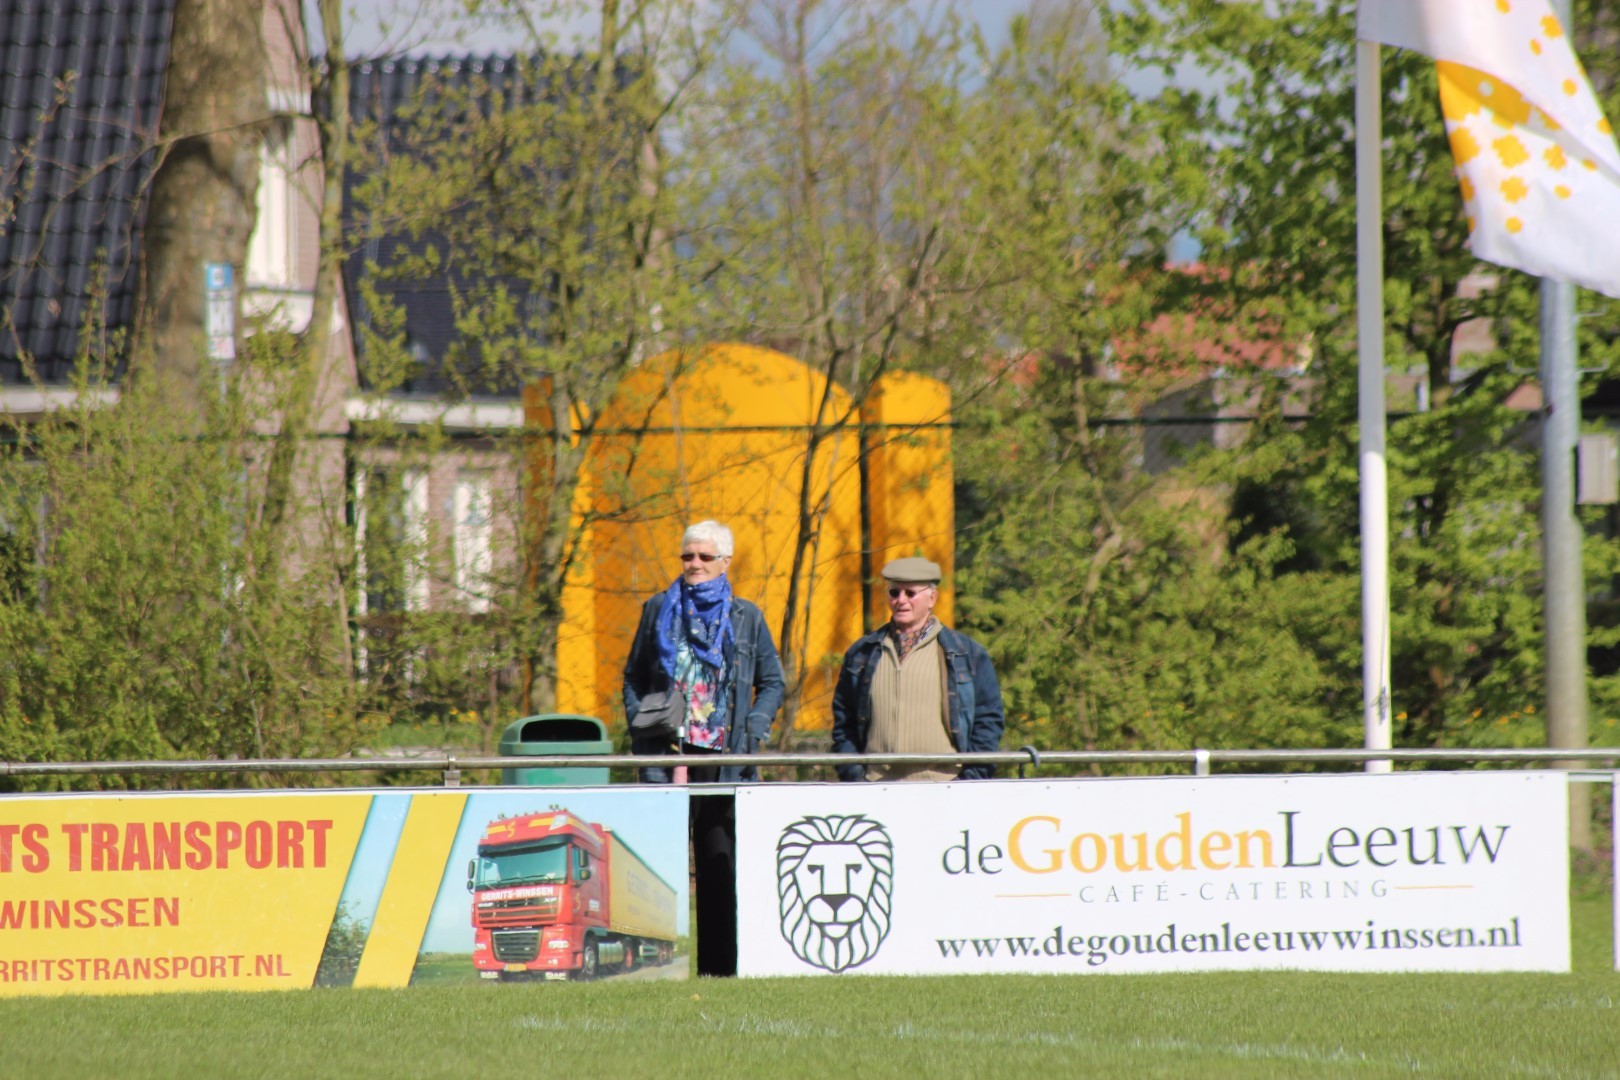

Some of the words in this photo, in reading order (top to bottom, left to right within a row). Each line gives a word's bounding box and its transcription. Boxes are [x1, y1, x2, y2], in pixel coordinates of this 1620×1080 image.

[62, 819, 334, 872] TRANSPORT
[941, 811, 1512, 876] deGoudenLeeuw
[0, 897, 180, 930] WINSSEN
[1079, 878, 1388, 904] CAFÉ-CATERING
[935, 916, 1523, 966] www.degoudenleeuwwinssen.nl
